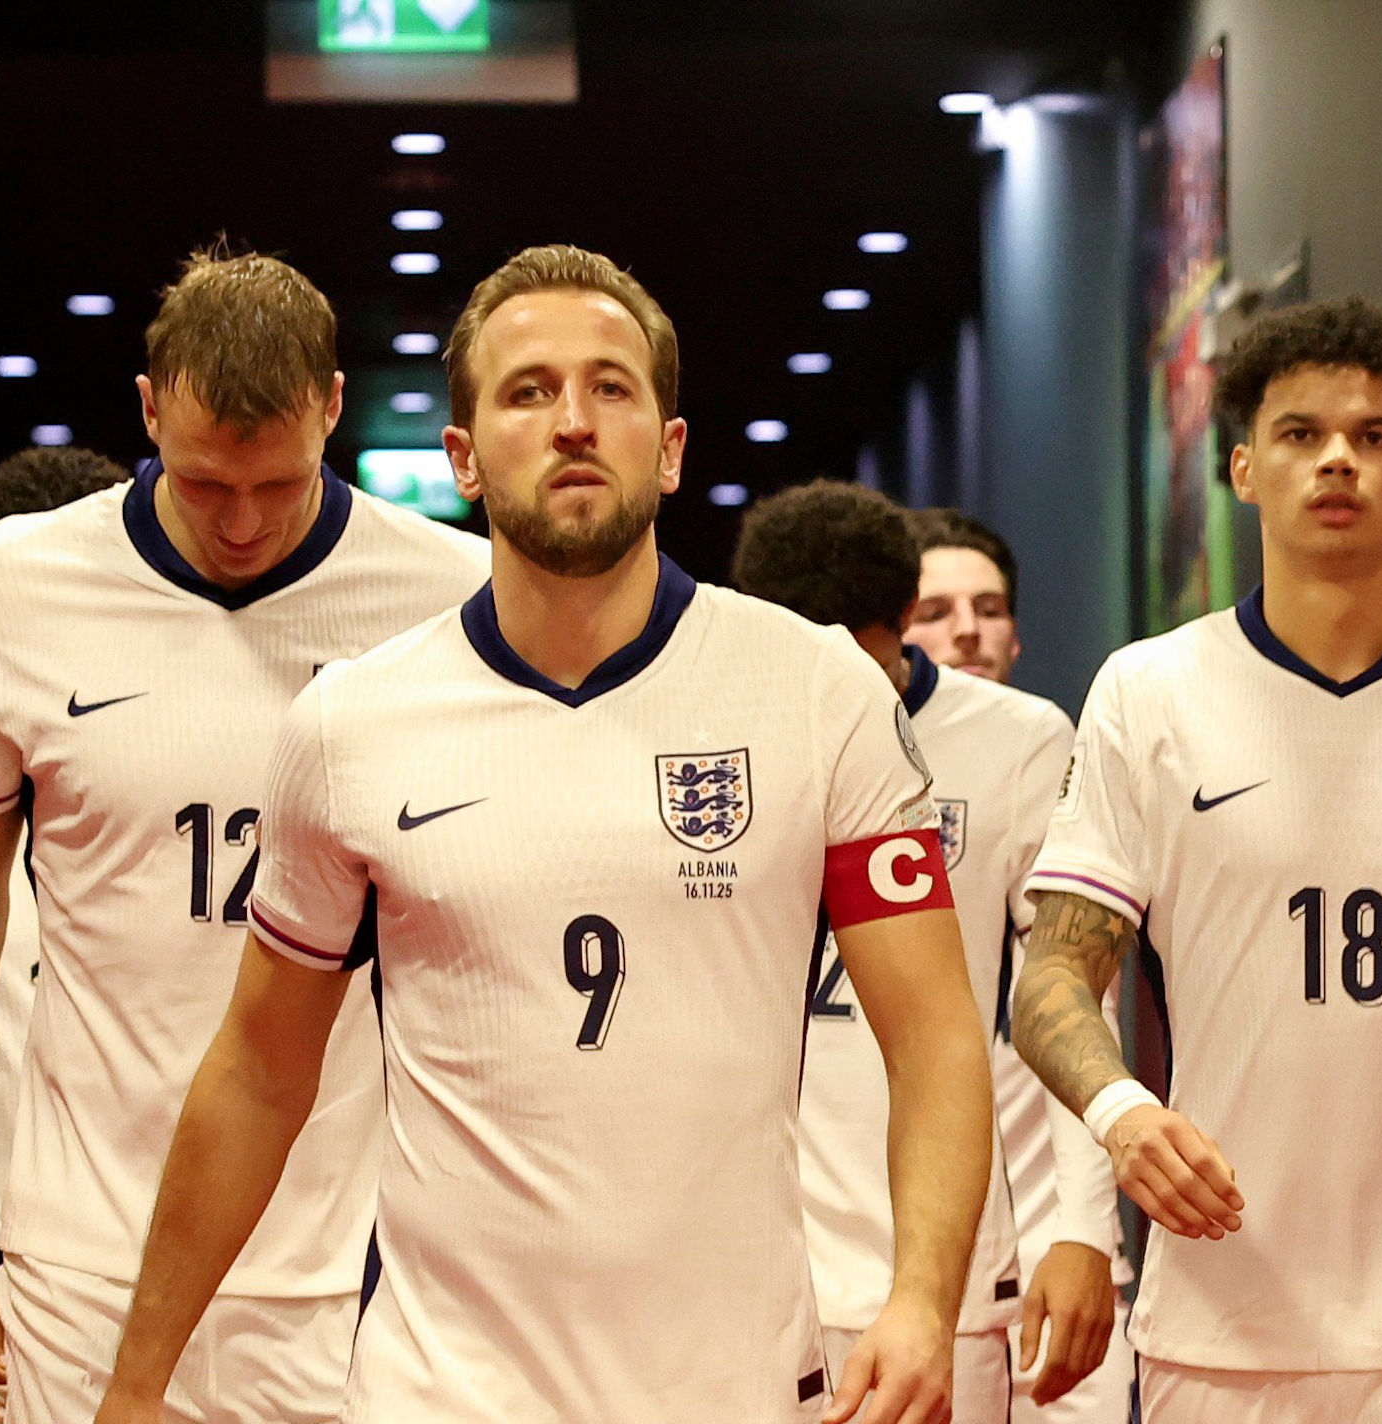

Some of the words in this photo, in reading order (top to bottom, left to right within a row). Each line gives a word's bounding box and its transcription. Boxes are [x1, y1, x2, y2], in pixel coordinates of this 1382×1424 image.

[175, 803, 261, 927] 12
[678, 861, 738, 878] ALBANIA
[684, 882, 733, 899] 16.11.25
[868, 837, 933, 903] C
[562, 914, 625, 1052] 9
